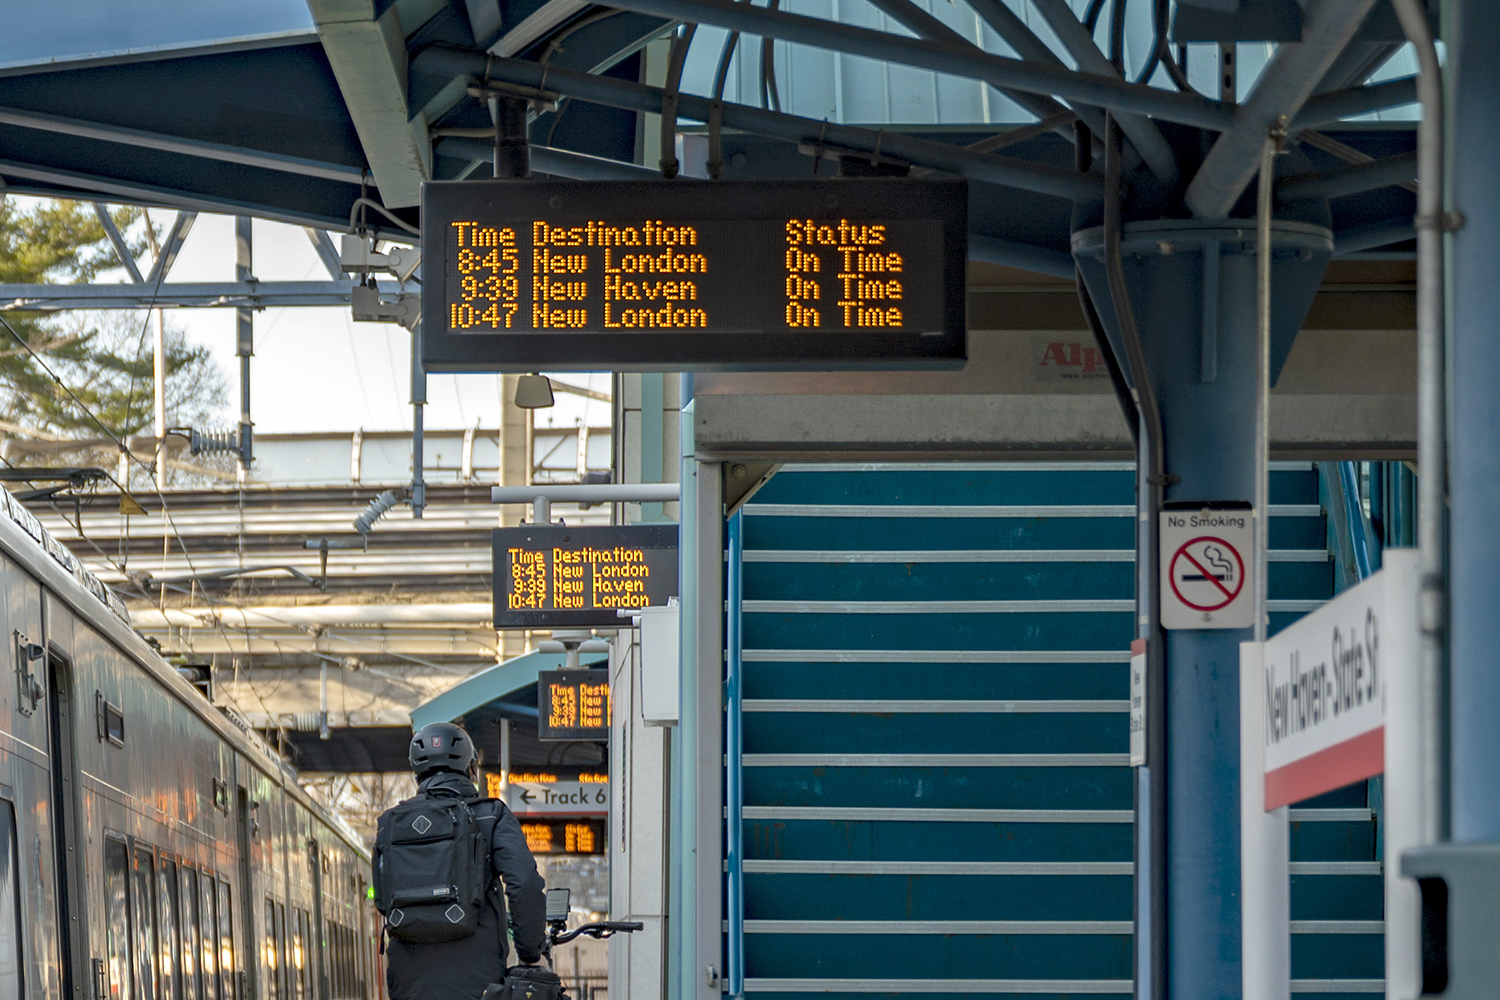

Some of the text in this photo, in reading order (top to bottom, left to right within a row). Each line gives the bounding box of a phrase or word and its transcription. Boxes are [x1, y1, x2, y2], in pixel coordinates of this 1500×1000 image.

[451, 219, 886, 246] Time Destination Status
[457, 246, 903, 274] 8:45 New London On Time
[461, 273, 903, 301] 9:39 New Haven On Time
[450, 301, 903, 329] 10:47 New London On Time
[1168, 516, 1245, 529] No Smoking
[508, 547, 644, 563] Time Destination
[512, 562, 650, 578] 8:45 New London
[513, 578, 644, 593] 9:39 New Haven
[508, 593, 650, 609] 10:47 New London
[549, 684, 575, 696] Time
[580, 695, 602, 706] New
[580, 706, 602, 716] New
[580, 716, 602, 727] New
[542, 787, 606, 804] Track 6
